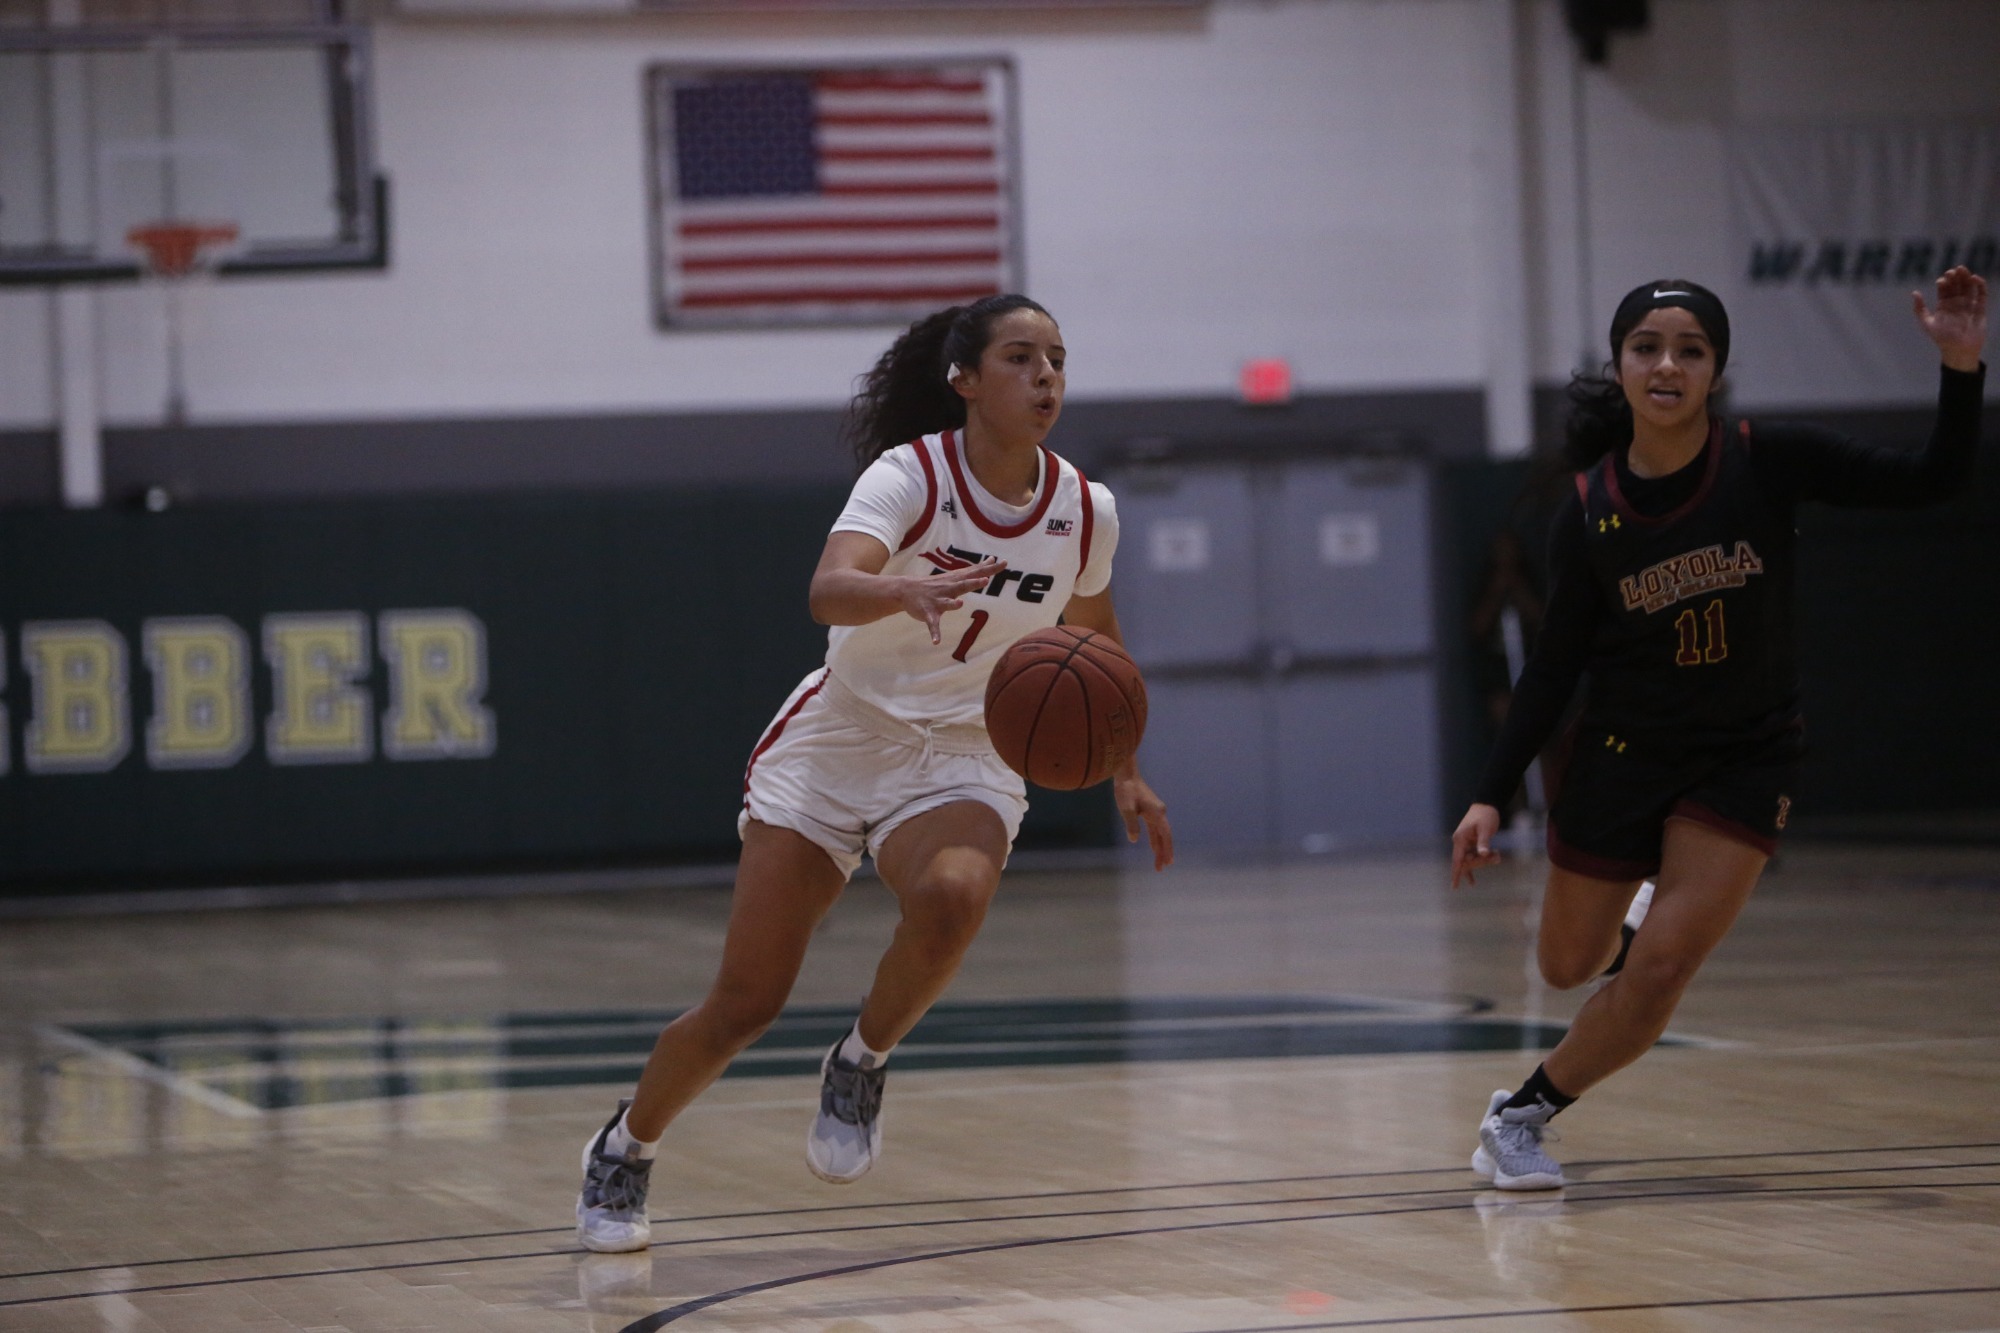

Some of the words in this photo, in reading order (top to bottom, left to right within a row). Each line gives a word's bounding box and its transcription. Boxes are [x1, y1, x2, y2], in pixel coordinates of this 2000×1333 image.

[1619, 540, 1763, 611] LOYOLA
[952, 609, 989, 663] 1
[1674, 599, 1728, 666] 11
[0, 607, 498, 775] BBER
